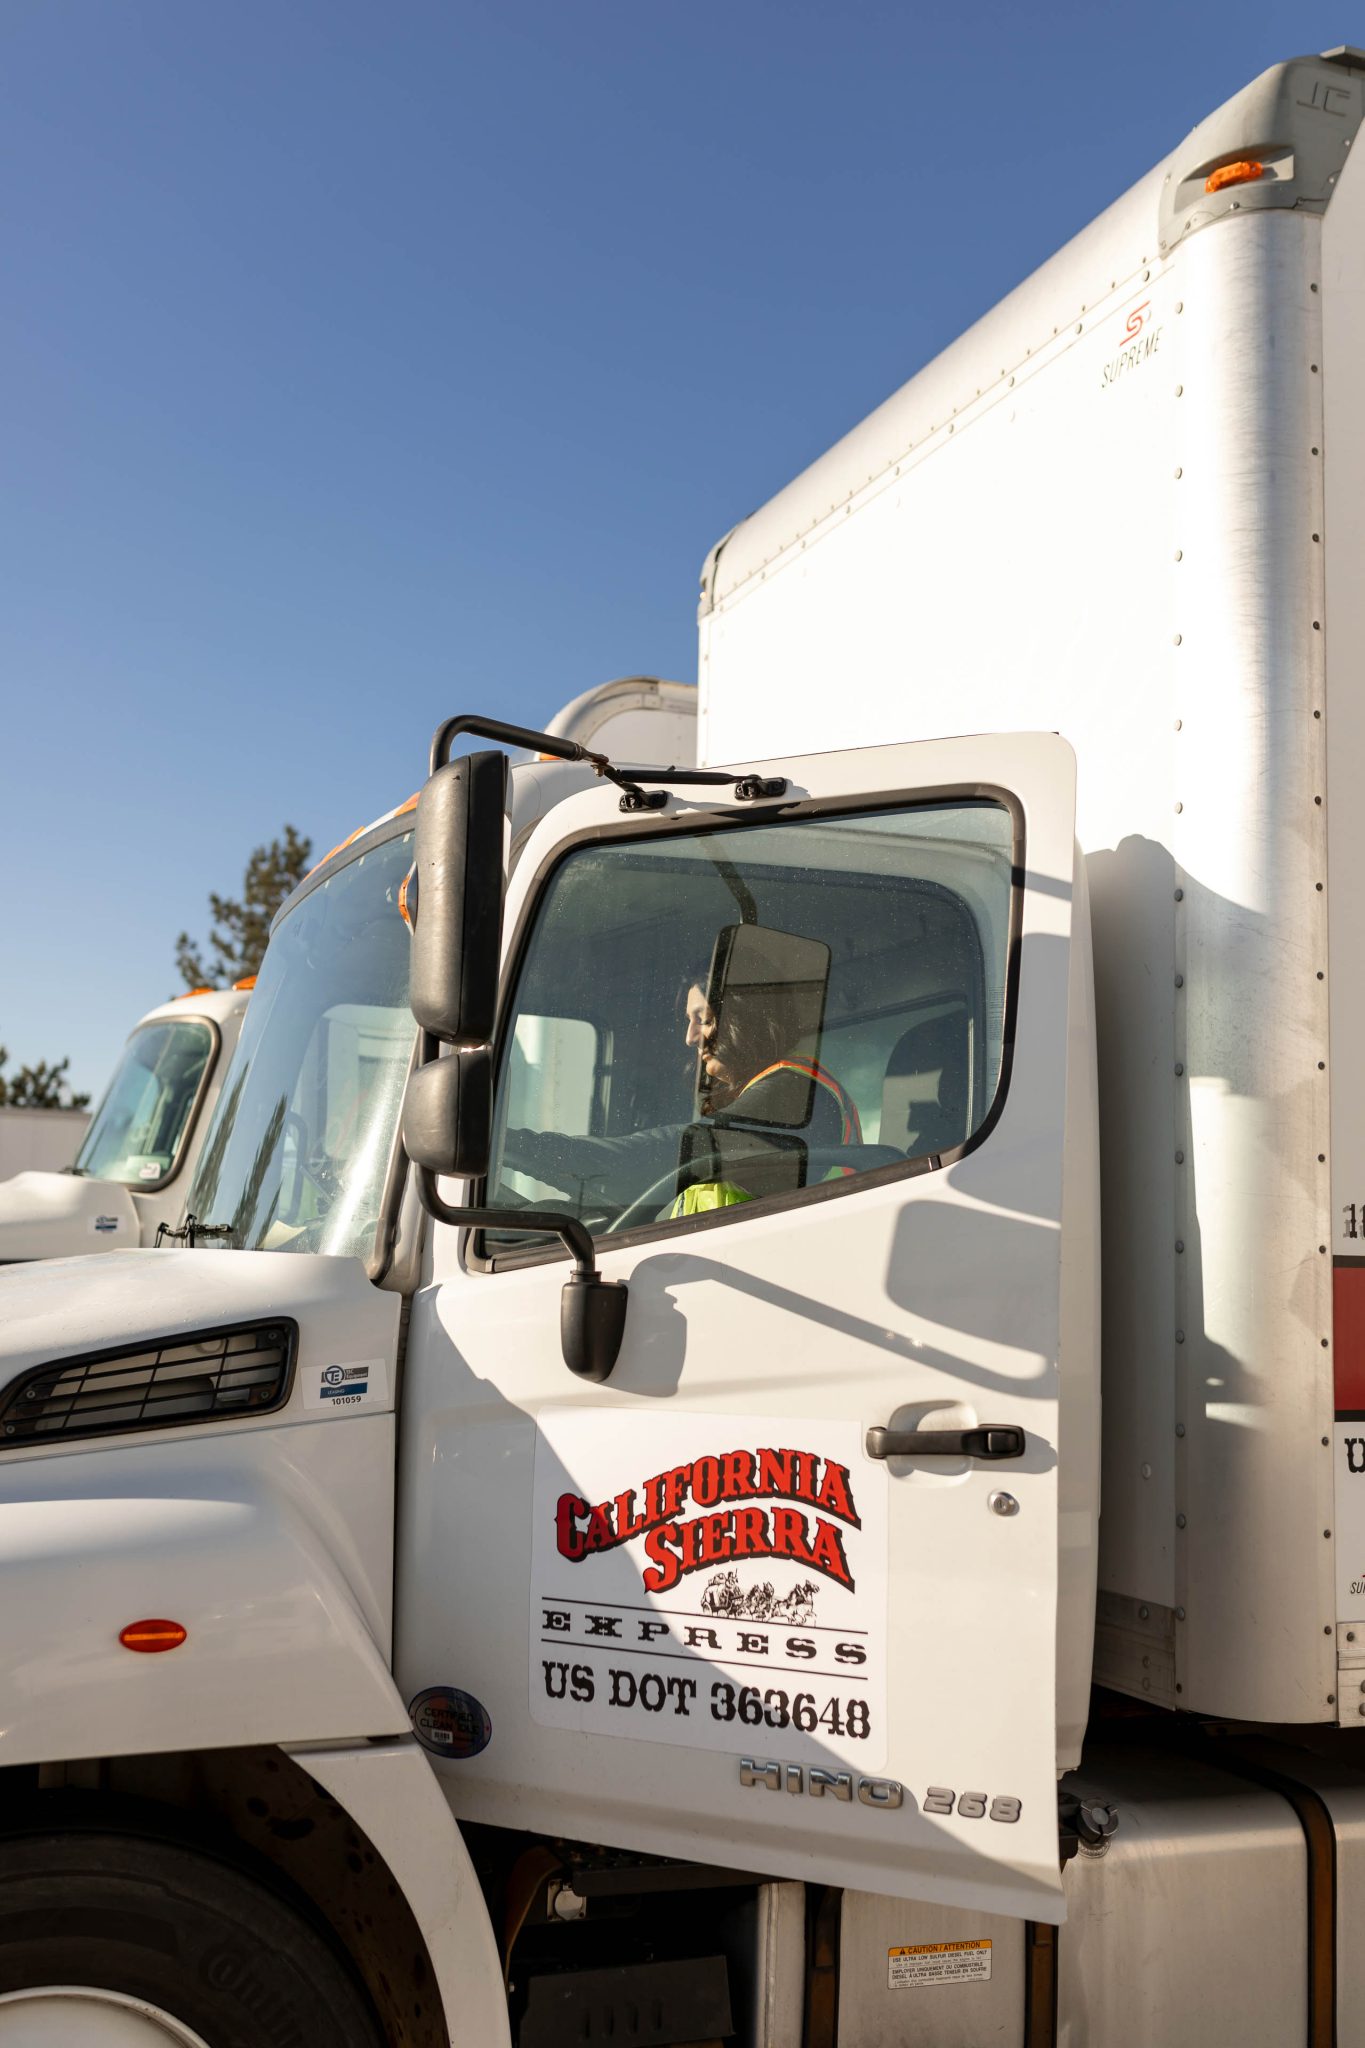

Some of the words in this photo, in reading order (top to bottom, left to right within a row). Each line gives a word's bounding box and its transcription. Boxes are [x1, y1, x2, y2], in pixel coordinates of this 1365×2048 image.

[1102, 326, 1163, 388] SUPREME
[332, 1395, 362, 1405] 101059
[554, 1448, 862, 1563] CALIFORNIA
[642, 1506, 855, 1594] SIERRA
[542, 1610, 868, 1666] EXPRESS
[542, 1660, 595, 1702] US
[608, 1668, 697, 1716] DOT
[710, 1681, 871, 1740] 363648
[740, 1758, 904, 1810] HINO
[922, 1786, 1023, 1823] 268
[908, 1944, 938, 1954] CAUTION
[943, 1942, 980, 1951] ATTENTION
